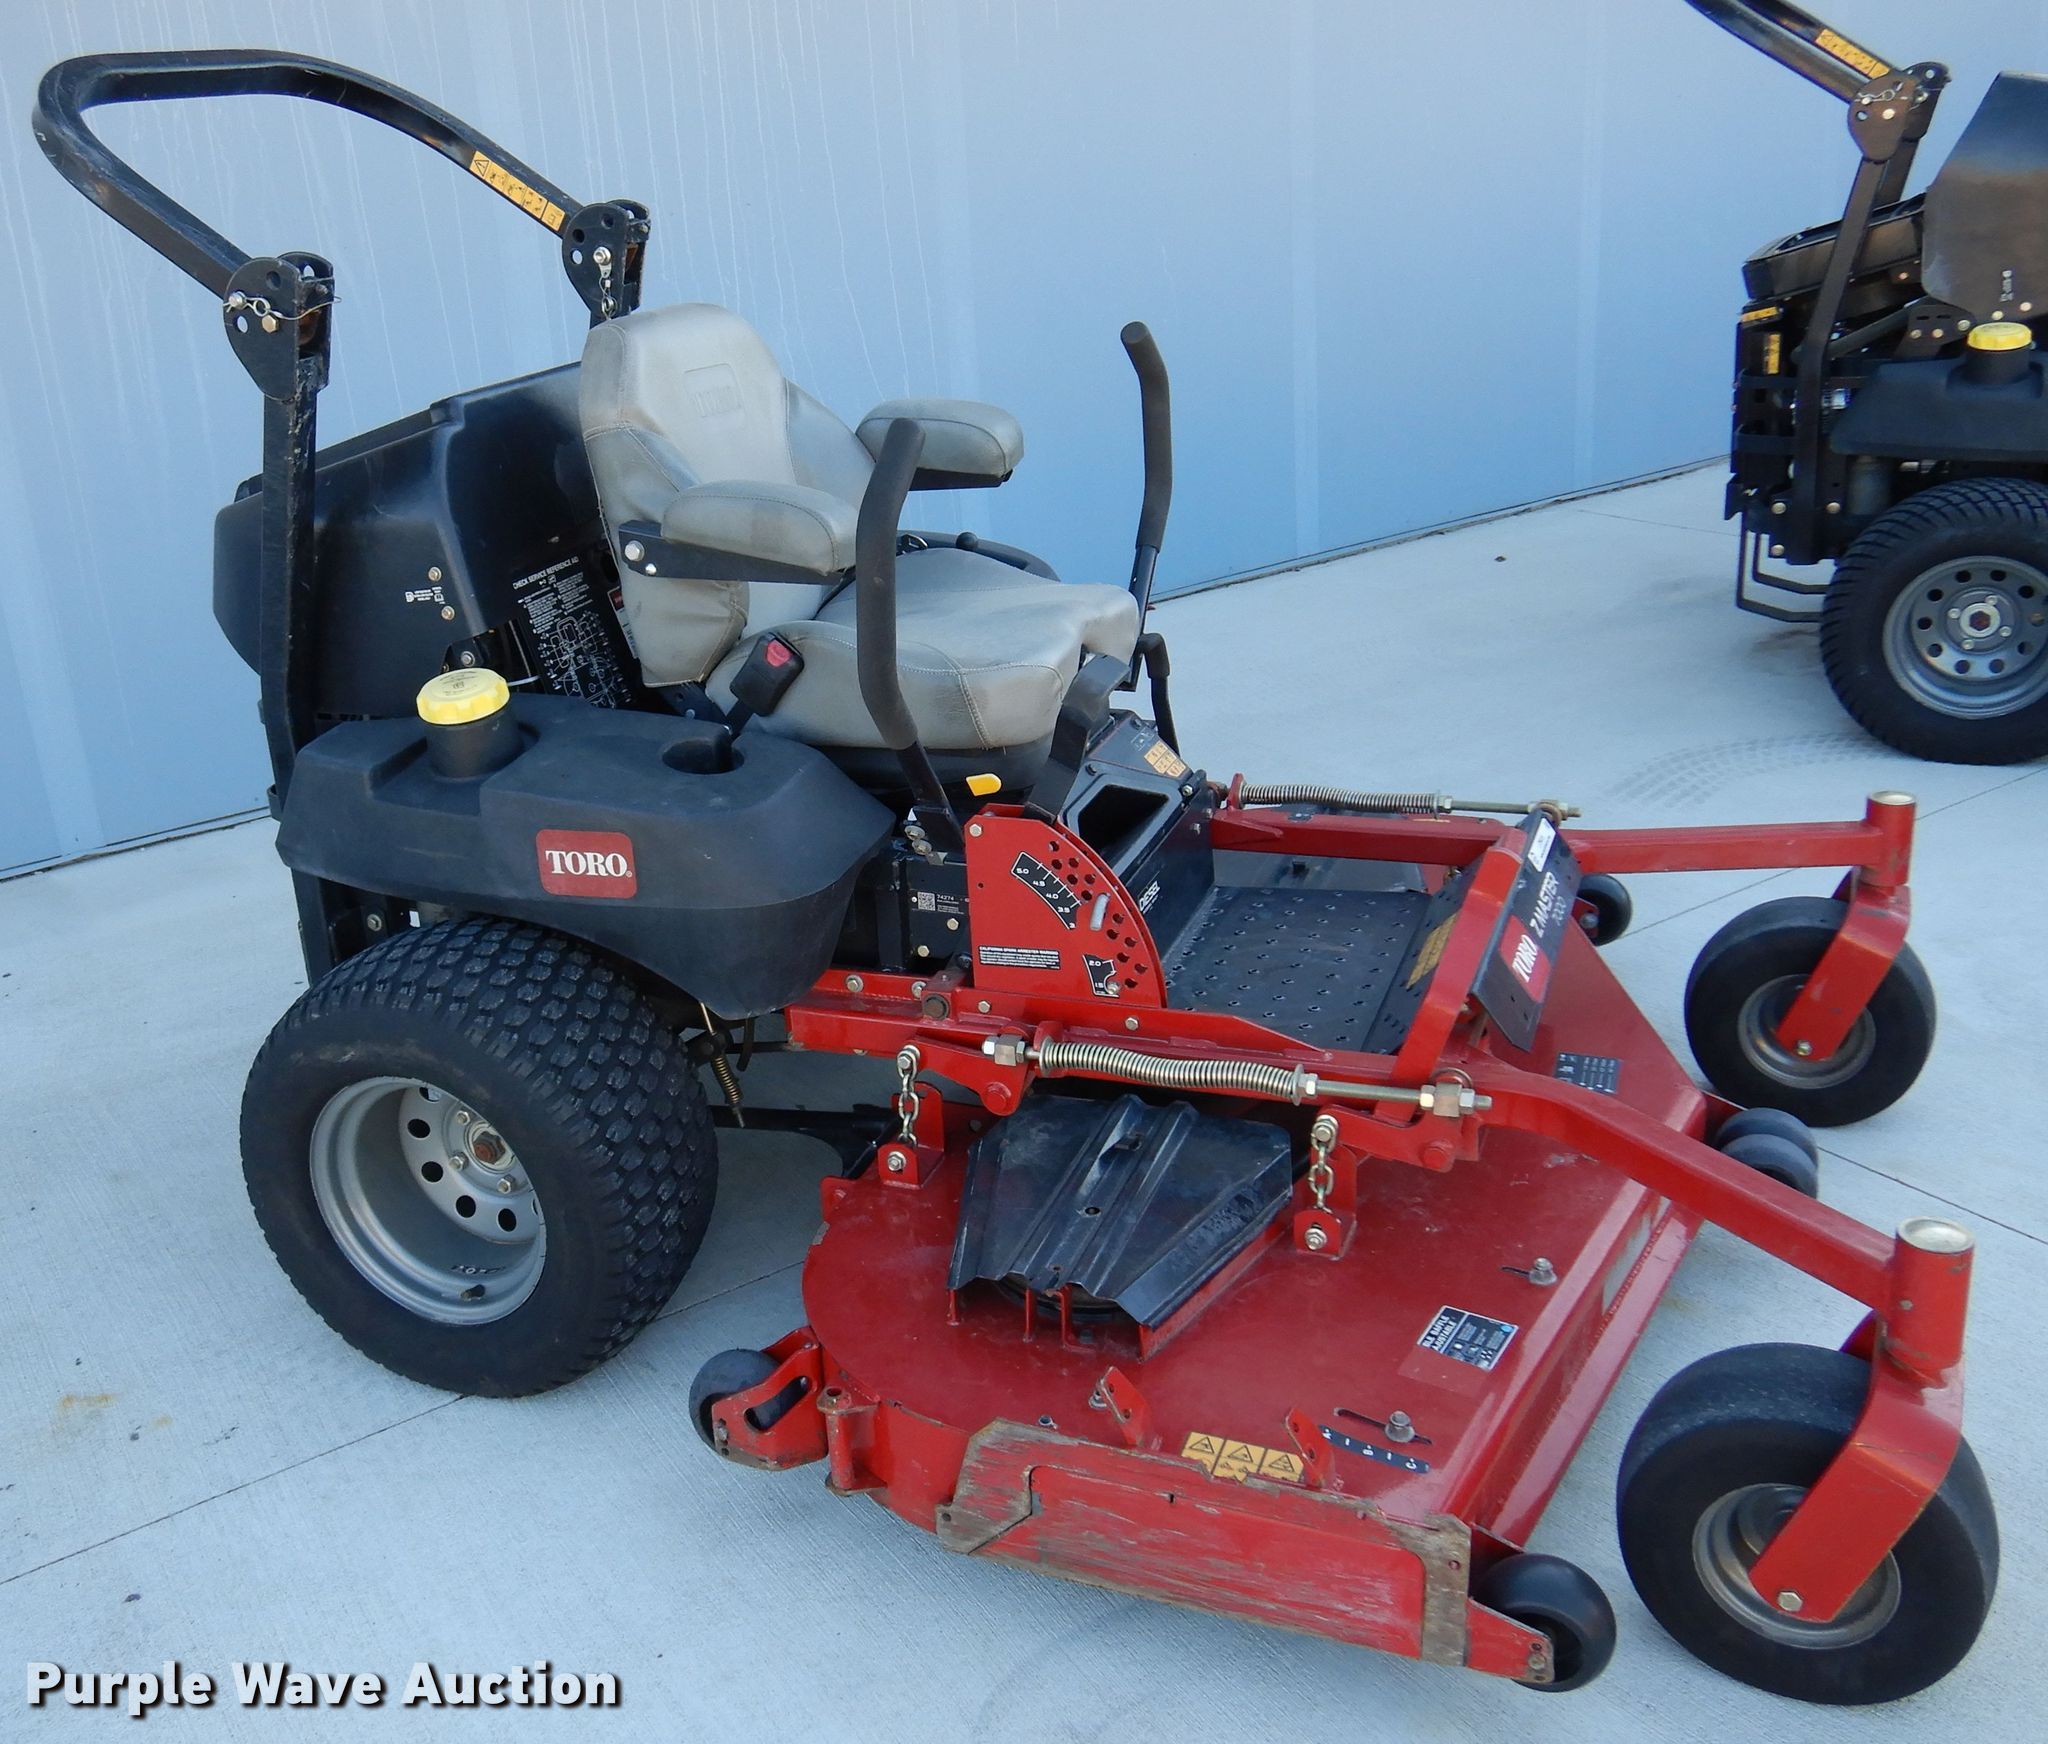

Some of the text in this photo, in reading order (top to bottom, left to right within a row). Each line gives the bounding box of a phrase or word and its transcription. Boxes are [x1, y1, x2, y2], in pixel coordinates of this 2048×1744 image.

[512, 578, 529, 590] CHECK
[528, 569, 548, 583] SERVICE
[546, 558, 573, 575] REFERENCE
[545, 850, 628, 878] TORO
[1534, 871, 1561, 926] MASTER
[1512, 934, 1538, 983] TORO
